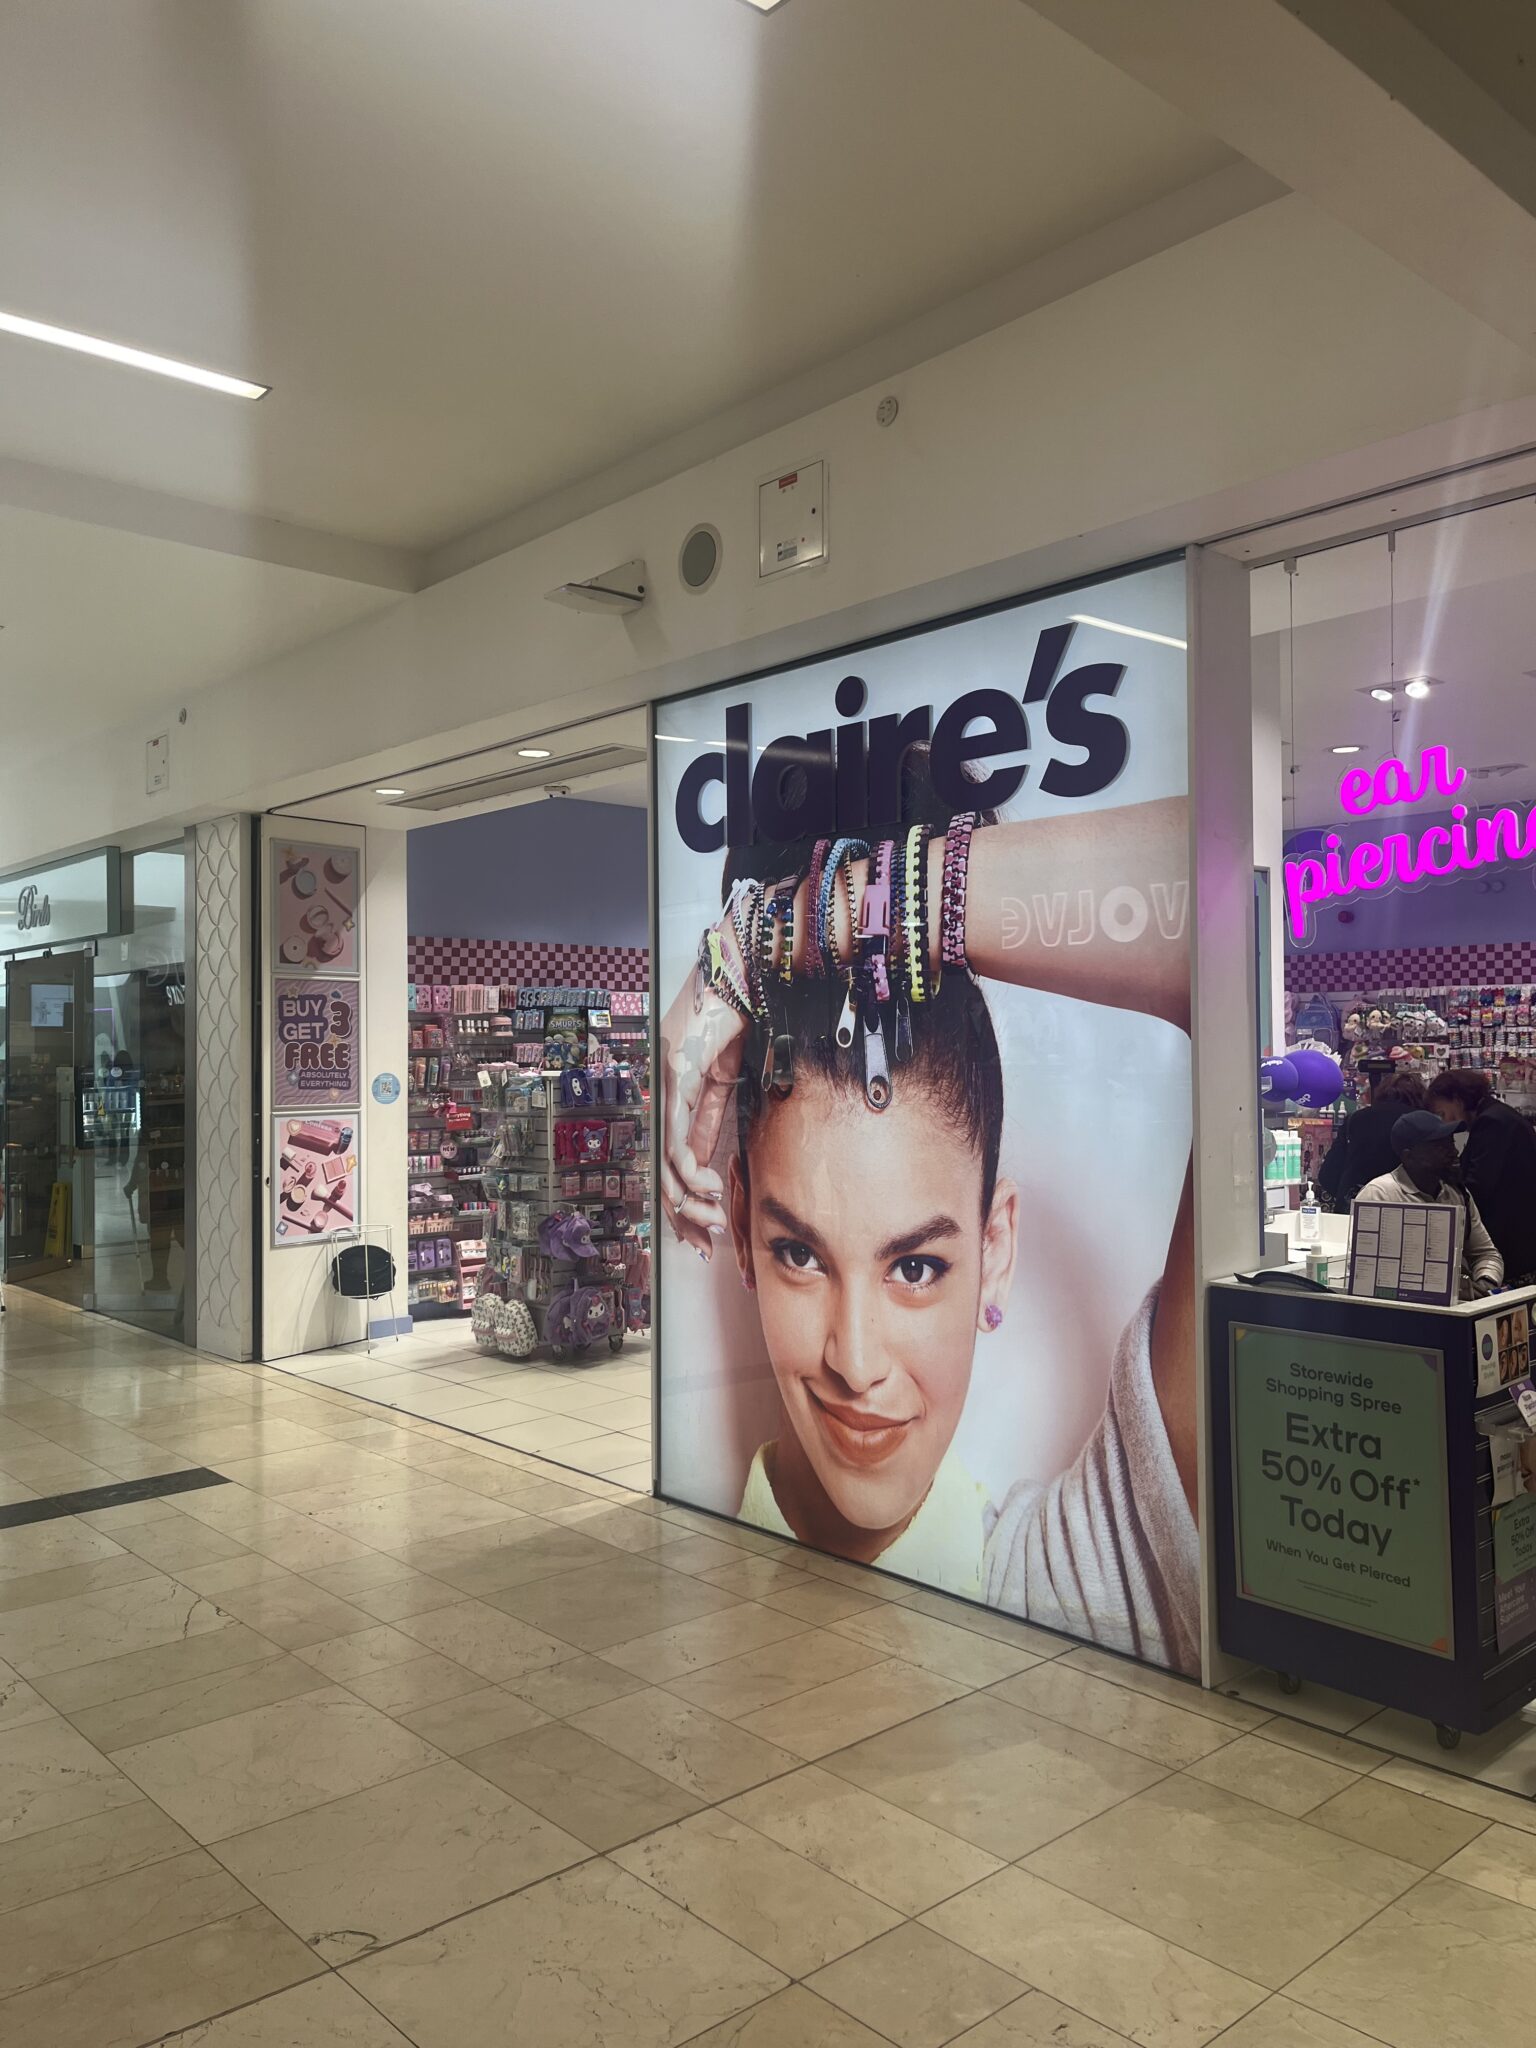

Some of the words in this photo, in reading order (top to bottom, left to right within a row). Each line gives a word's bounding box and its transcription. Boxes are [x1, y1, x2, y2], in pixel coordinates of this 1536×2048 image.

[675, 622, 1128, 853] claire's
[1340, 745, 1467, 815] ear
[283, 999, 322, 1017] BUY
[329, 1000, 352, 1038] 3
[550, 1020, 582, 1029] SMURFS
[283, 1022, 324, 1041] GET
[284, 1041, 351, 1070] FREE
[300, 1071, 347, 1079] ABSOLUTELY
[300, 1080, 349, 1088] EVERYTHING!
[1290, 1363, 1374, 1389] Storewide
[1266, 1378, 1344, 1407] Shopping
[1350, 1392, 1402, 1414] Spree
[1286, 1412, 1381, 1460] Extra
[1262, 1449, 1341, 1495] 50%
[1280, 1494, 1392, 1556] Today
[1266, 1539, 1301, 1558] When
[1305, 1549, 1328, 1566] You
[1333, 1557, 1356, 1573] Get
[1360, 1564, 1411, 1587] Pierced
